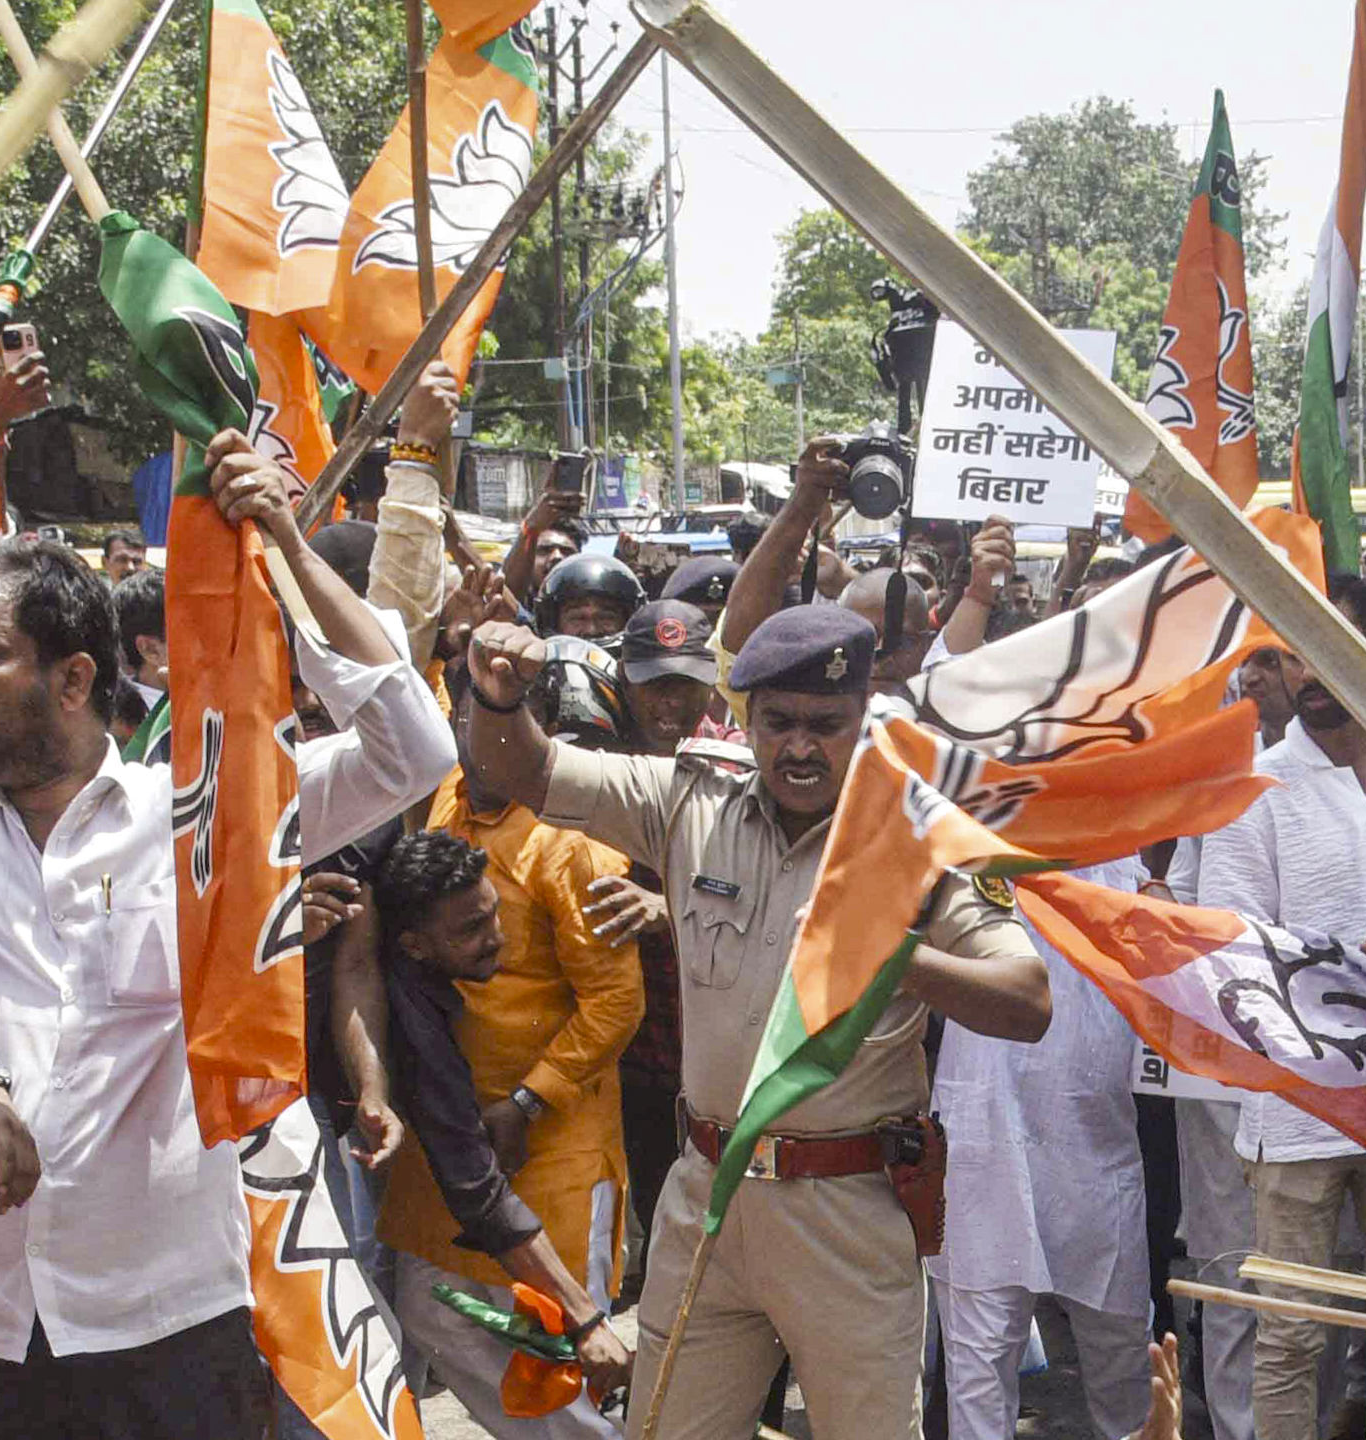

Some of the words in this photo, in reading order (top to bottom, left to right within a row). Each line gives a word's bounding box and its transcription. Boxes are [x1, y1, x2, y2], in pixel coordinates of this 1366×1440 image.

[953, 385, 1044, 413] अपमा
[932, 422, 1005, 456] नहीं
[1003, 426, 1091, 462] सहेगा
[957, 467, 1050, 504] बिहार
